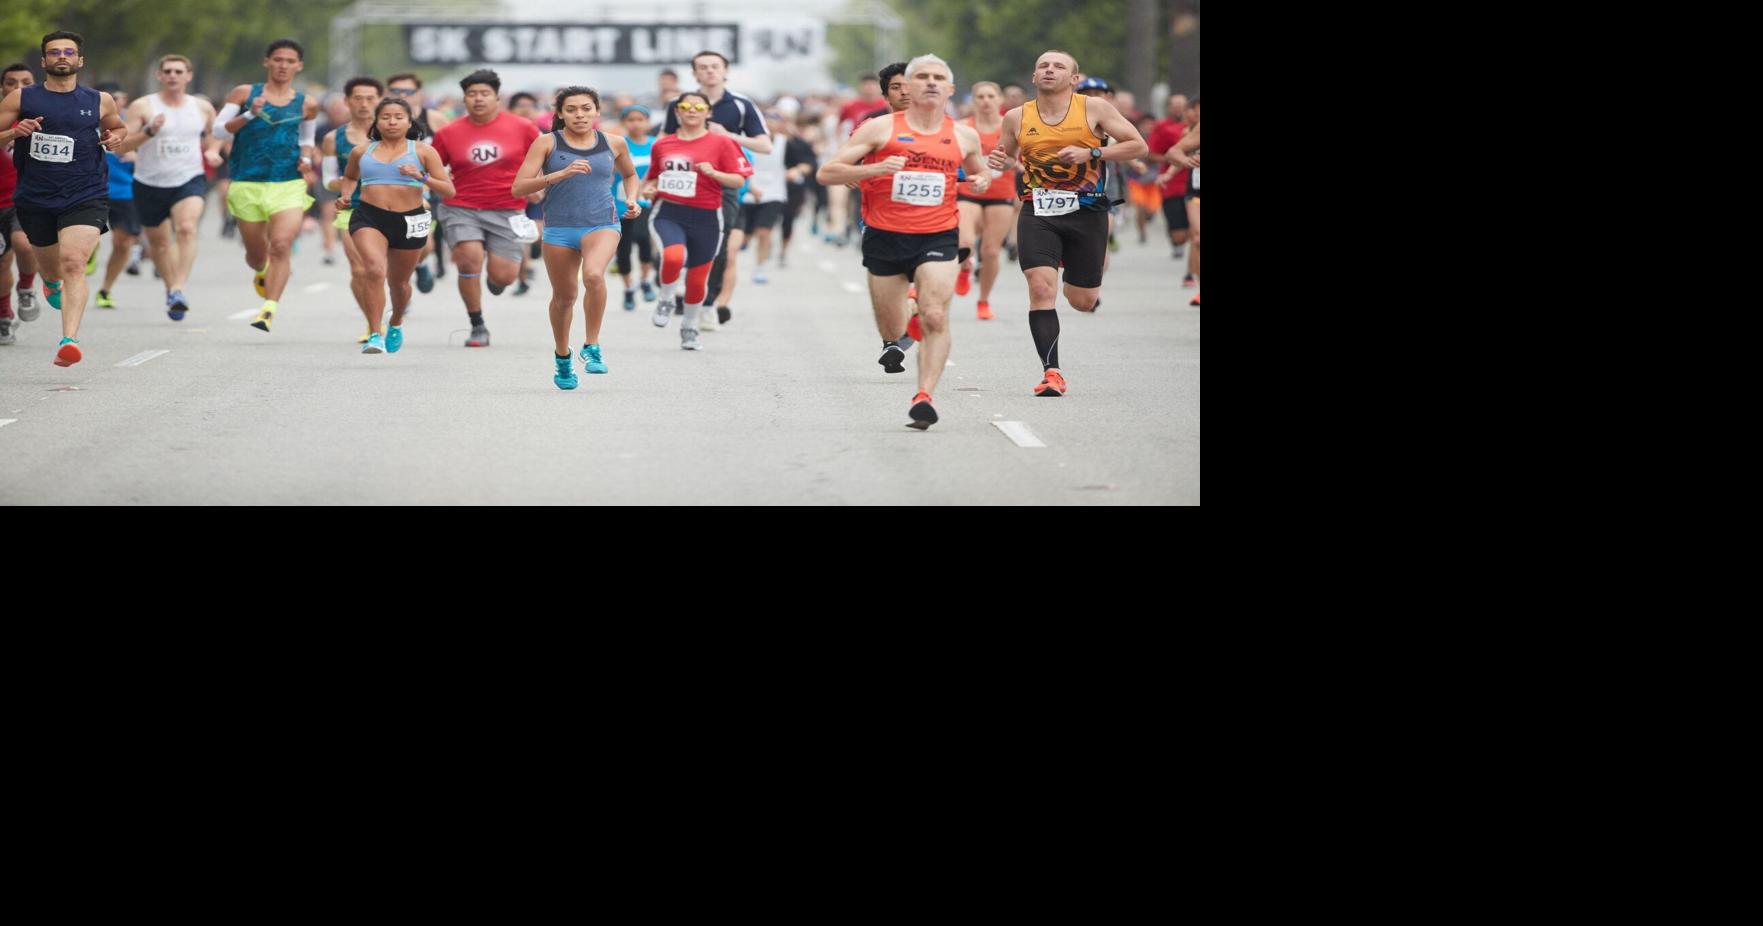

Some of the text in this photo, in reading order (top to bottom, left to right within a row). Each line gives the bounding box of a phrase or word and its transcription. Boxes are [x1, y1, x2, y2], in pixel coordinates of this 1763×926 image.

[410, 26, 733, 63] 5K START LINE
[34, 142, 70, 156] 1614
[472, 146, 497, 162] RUN
[661, 179, 693, 190] 1607
[897, 183, 942, 197] 1255
[1036, 197, 1075, 209] 1797
